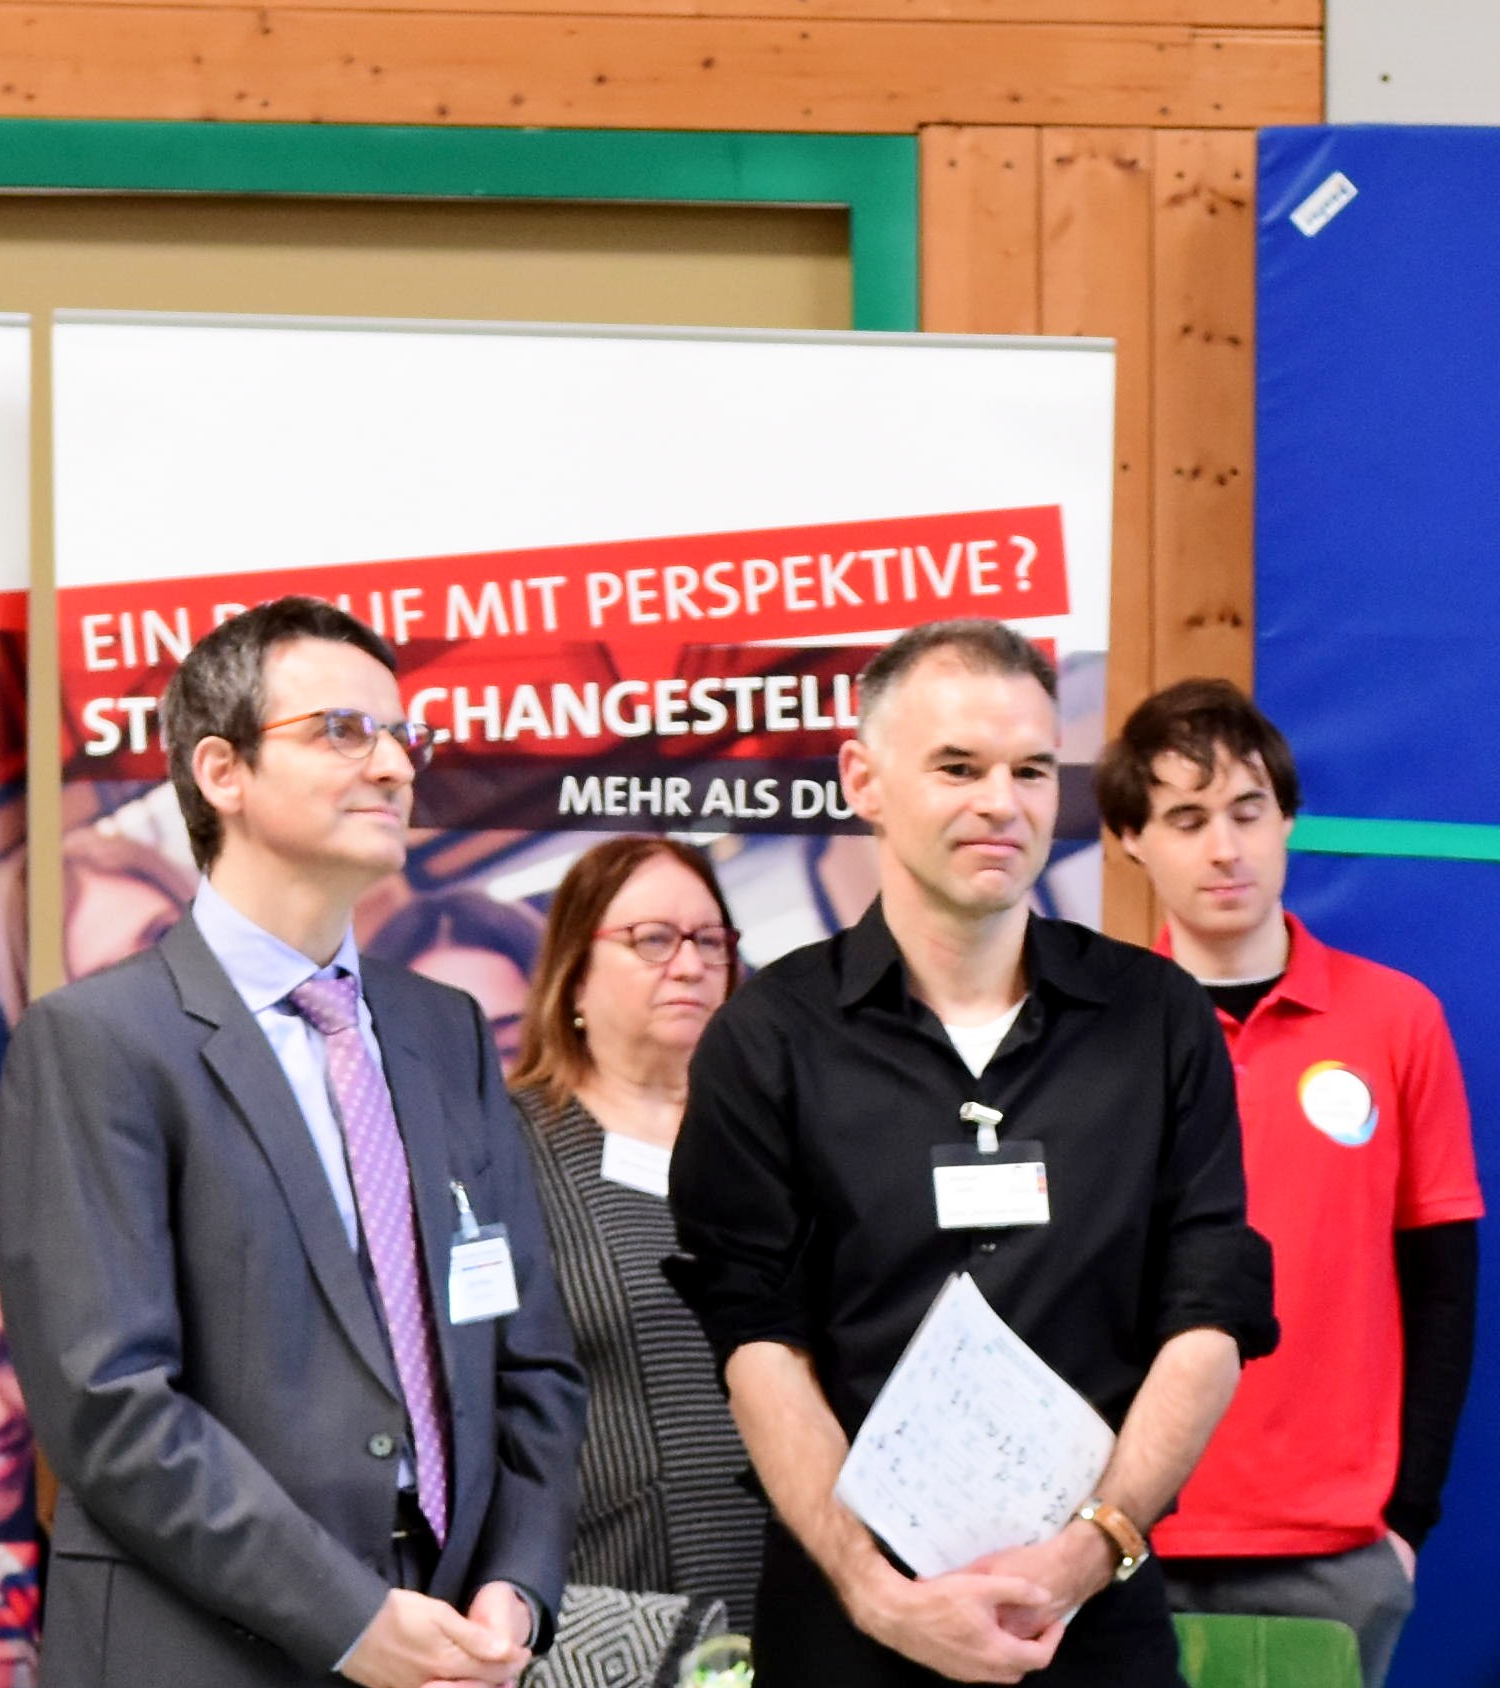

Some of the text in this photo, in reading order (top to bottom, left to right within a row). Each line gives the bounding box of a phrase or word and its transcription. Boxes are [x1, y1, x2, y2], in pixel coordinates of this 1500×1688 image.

[80, 605, 194, 672] EIN
[445, 575, 568, 640] MIT
[558, 775, 691, 818] MEHR
[700, 777, 780, 818] ALS
